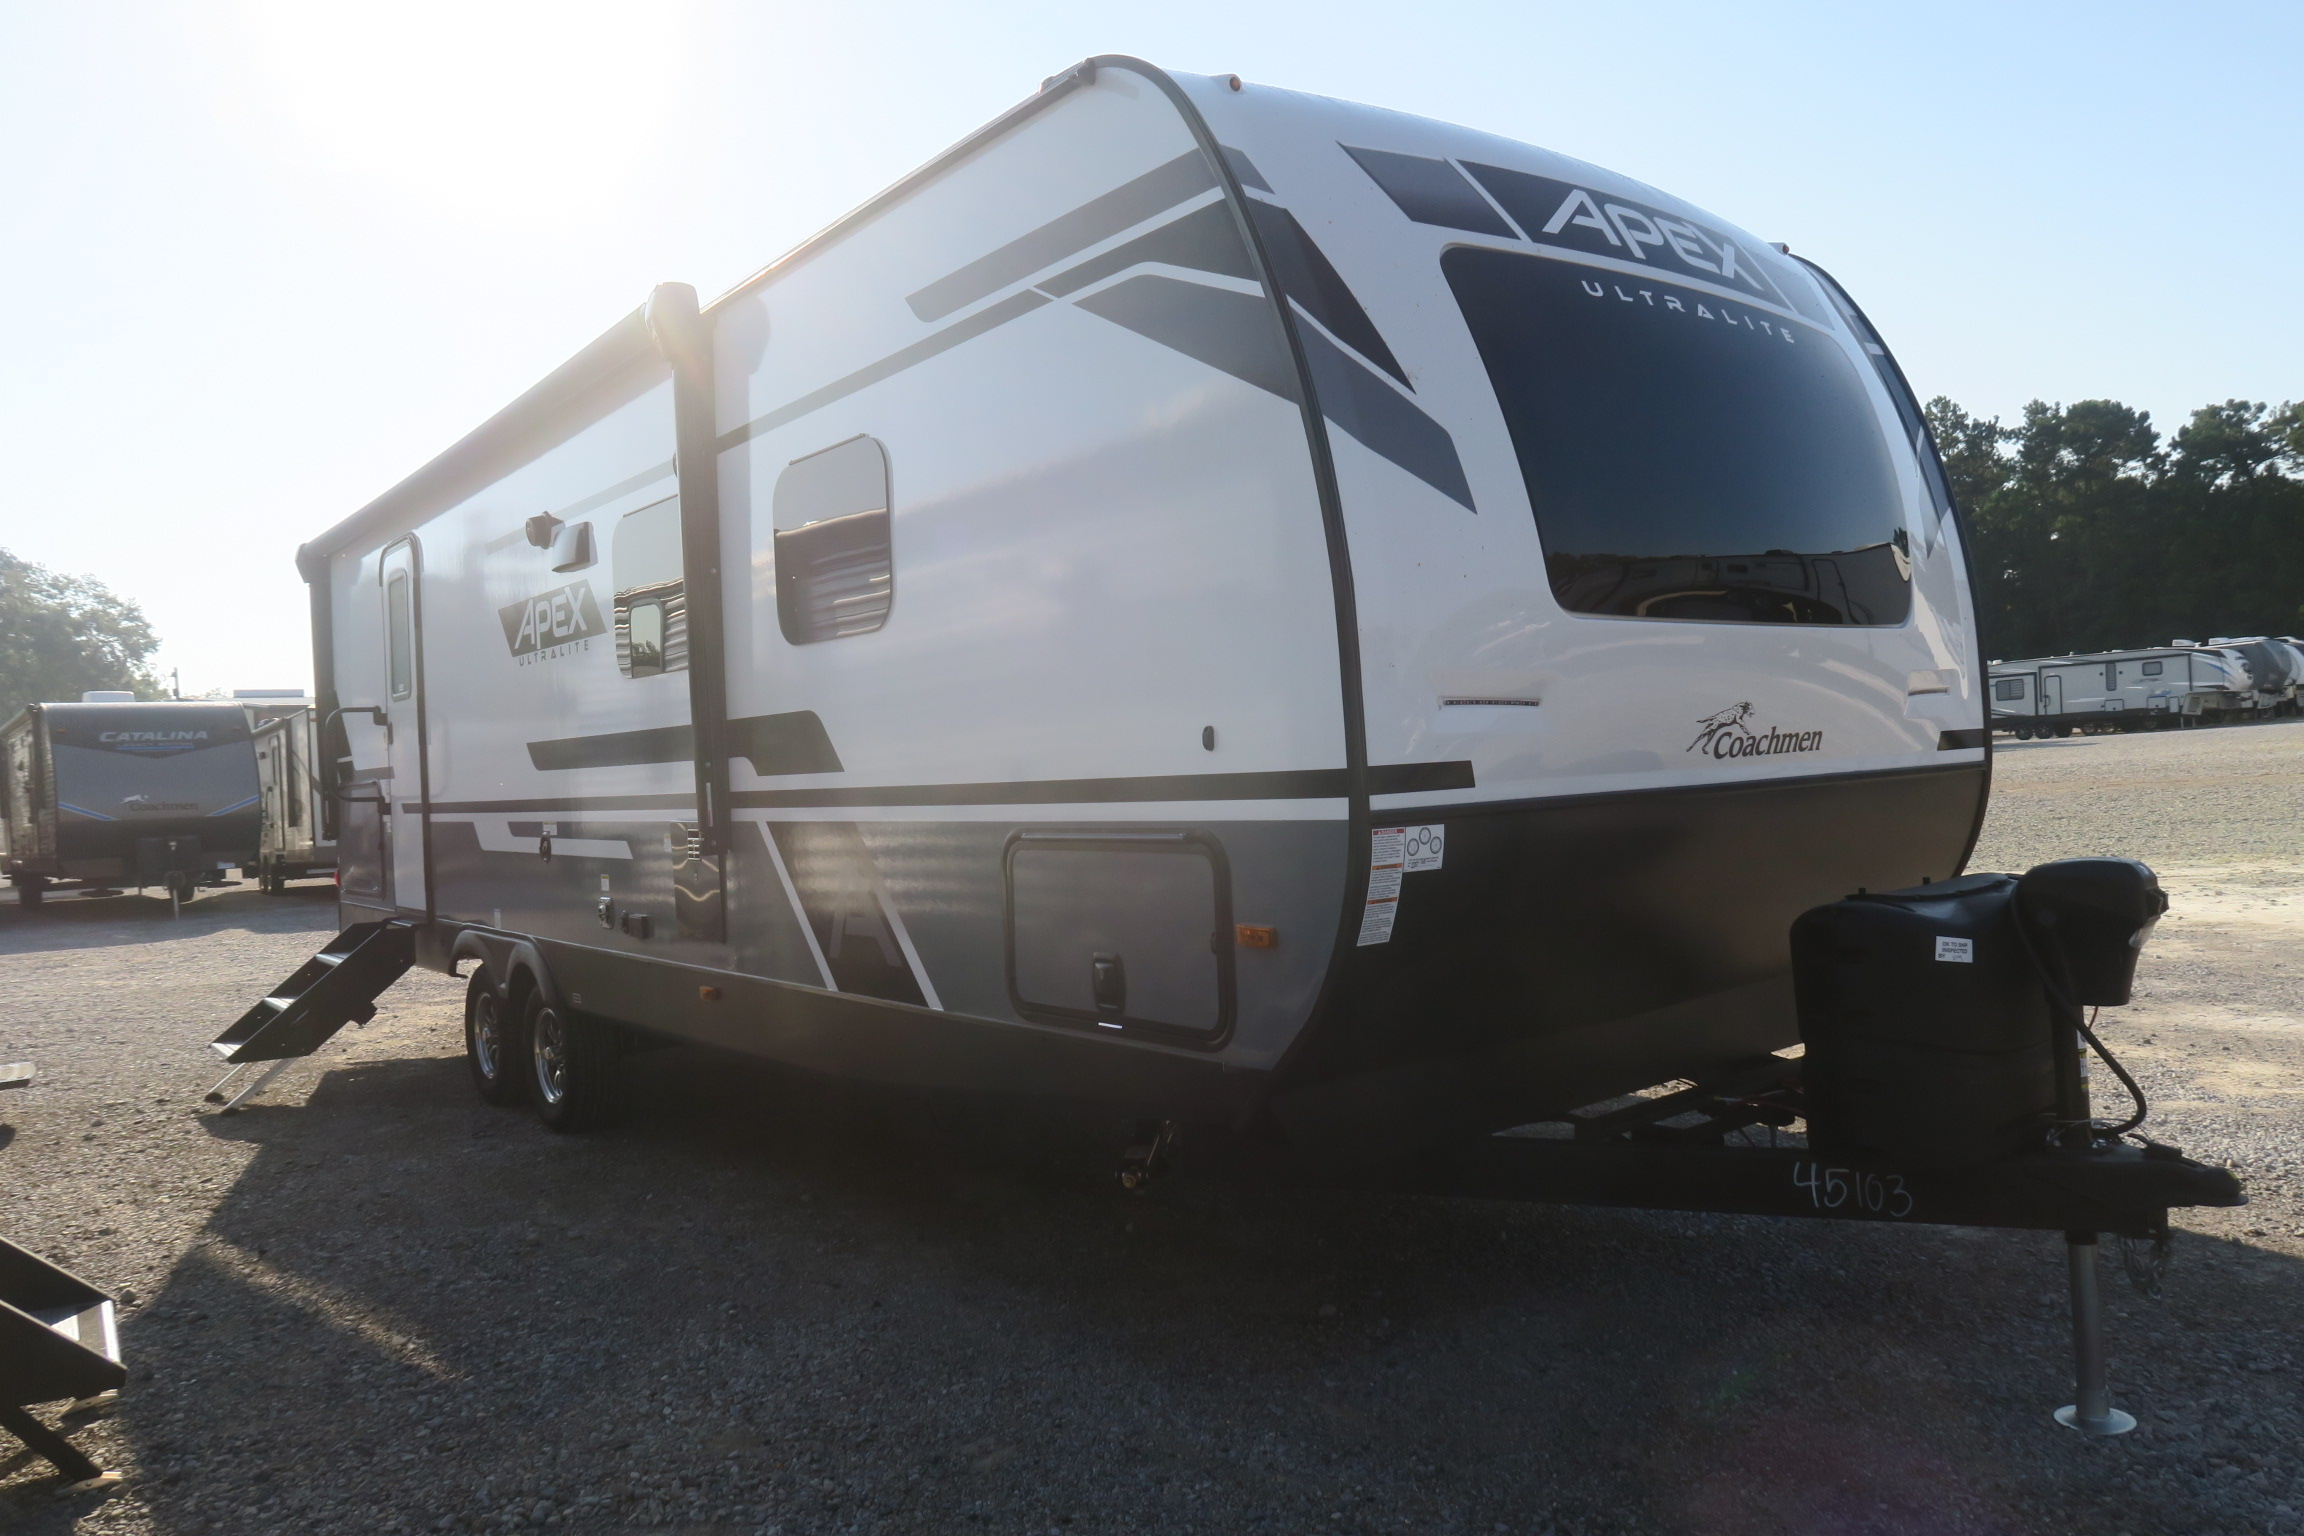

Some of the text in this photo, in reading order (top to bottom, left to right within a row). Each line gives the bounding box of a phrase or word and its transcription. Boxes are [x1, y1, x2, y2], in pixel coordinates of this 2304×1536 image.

[1542, 189, 1764, 291] APEX
[1582, 280, 1795, 344] ULTRALITE
[514, 586, 588, 649] APEX
[519, 640, 589, 667] ULTRALITE
[99, 730, 208, 742] CATALINA
[1713, 726, 1823, 759] Coachmen
[1793, 1161, 1913, 1218] 45103
